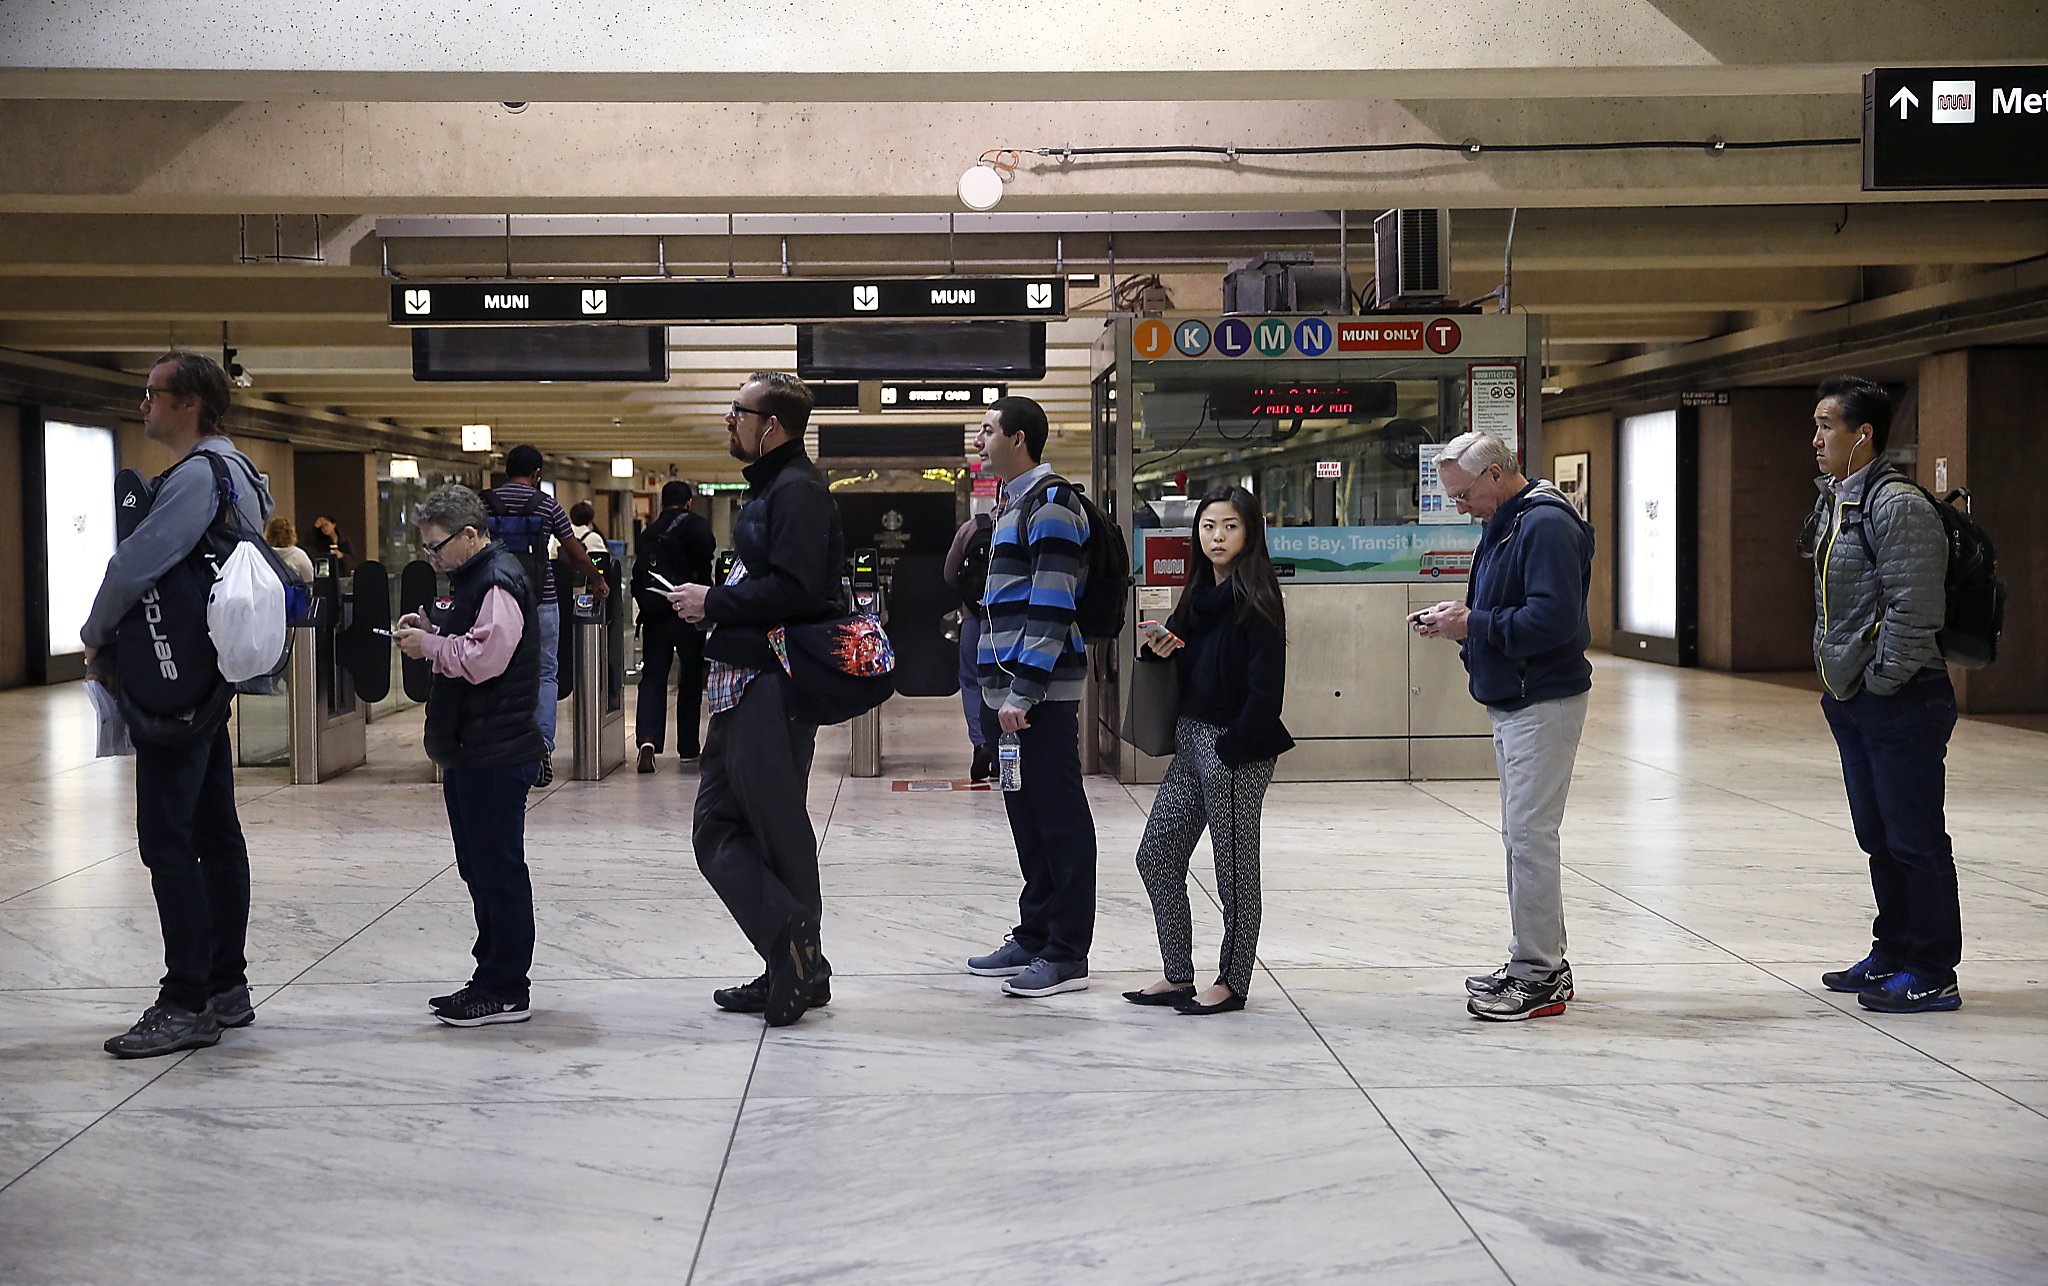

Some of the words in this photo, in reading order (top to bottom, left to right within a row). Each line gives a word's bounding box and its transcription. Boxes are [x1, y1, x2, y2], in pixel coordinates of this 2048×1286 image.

[484, 294, 529, 309] MUNI
[931, 289, 976, 304] MUNI
[1146, 327, 1158, 352] J
[1184, 328, 1201, 348] K
[1226, 325, 1241, 350] L
[1260, 325, 1286, 350] M
[1302, 324, 1323, 350] N
[1342, 329, 1379, 341] MUNI
[1383, 329, 1420, 341] ONLY
[1435, 326, 1452, 347] T
[1272, 535, 1303, 551] the
[1308, 535, 1345, 554] Bay.
[1348, 534, 1409, 550] Transit
